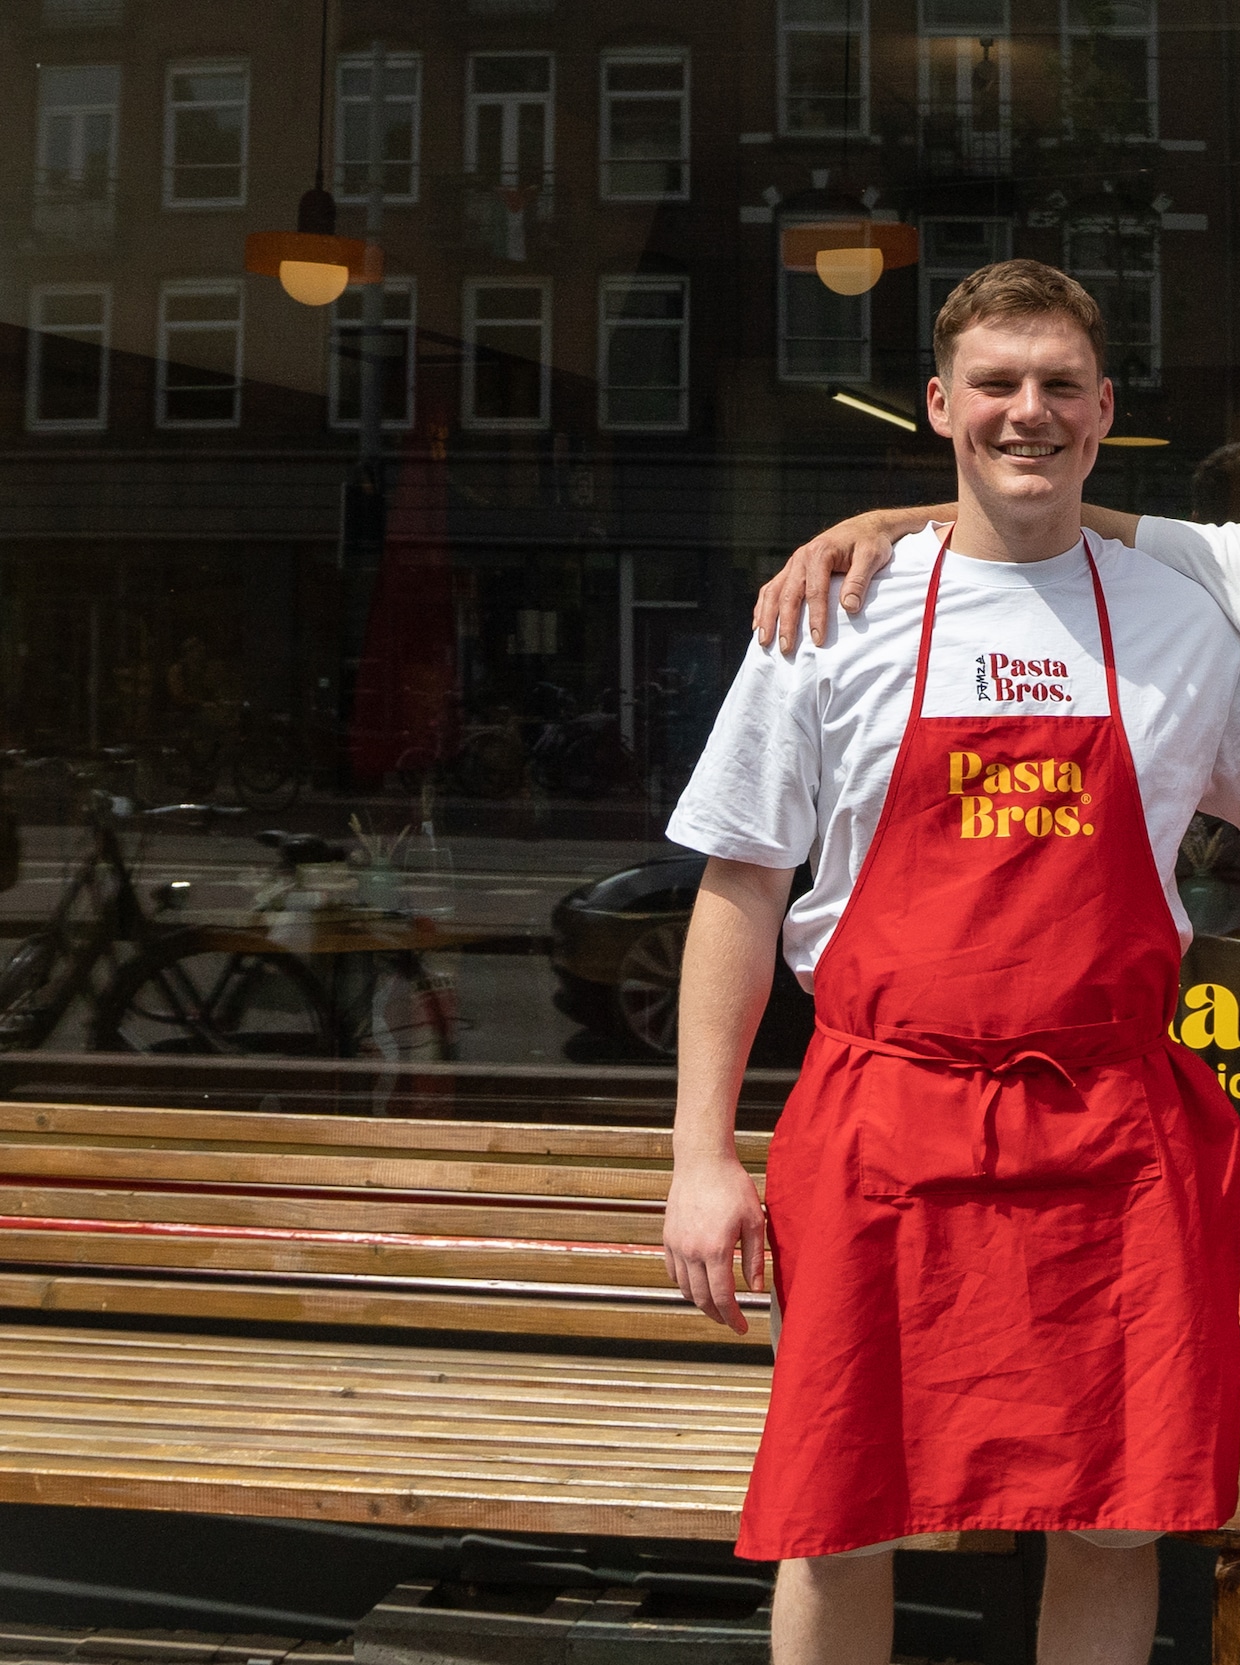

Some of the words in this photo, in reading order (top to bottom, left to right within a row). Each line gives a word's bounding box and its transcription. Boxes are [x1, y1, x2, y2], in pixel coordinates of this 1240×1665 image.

[988, 652, 1069, 678] Pasta
[991, 677, 1073, 702] Bros.
[948, 751, 1084, 795] Pasta
[960, 795, 1095, 839] Bros.
